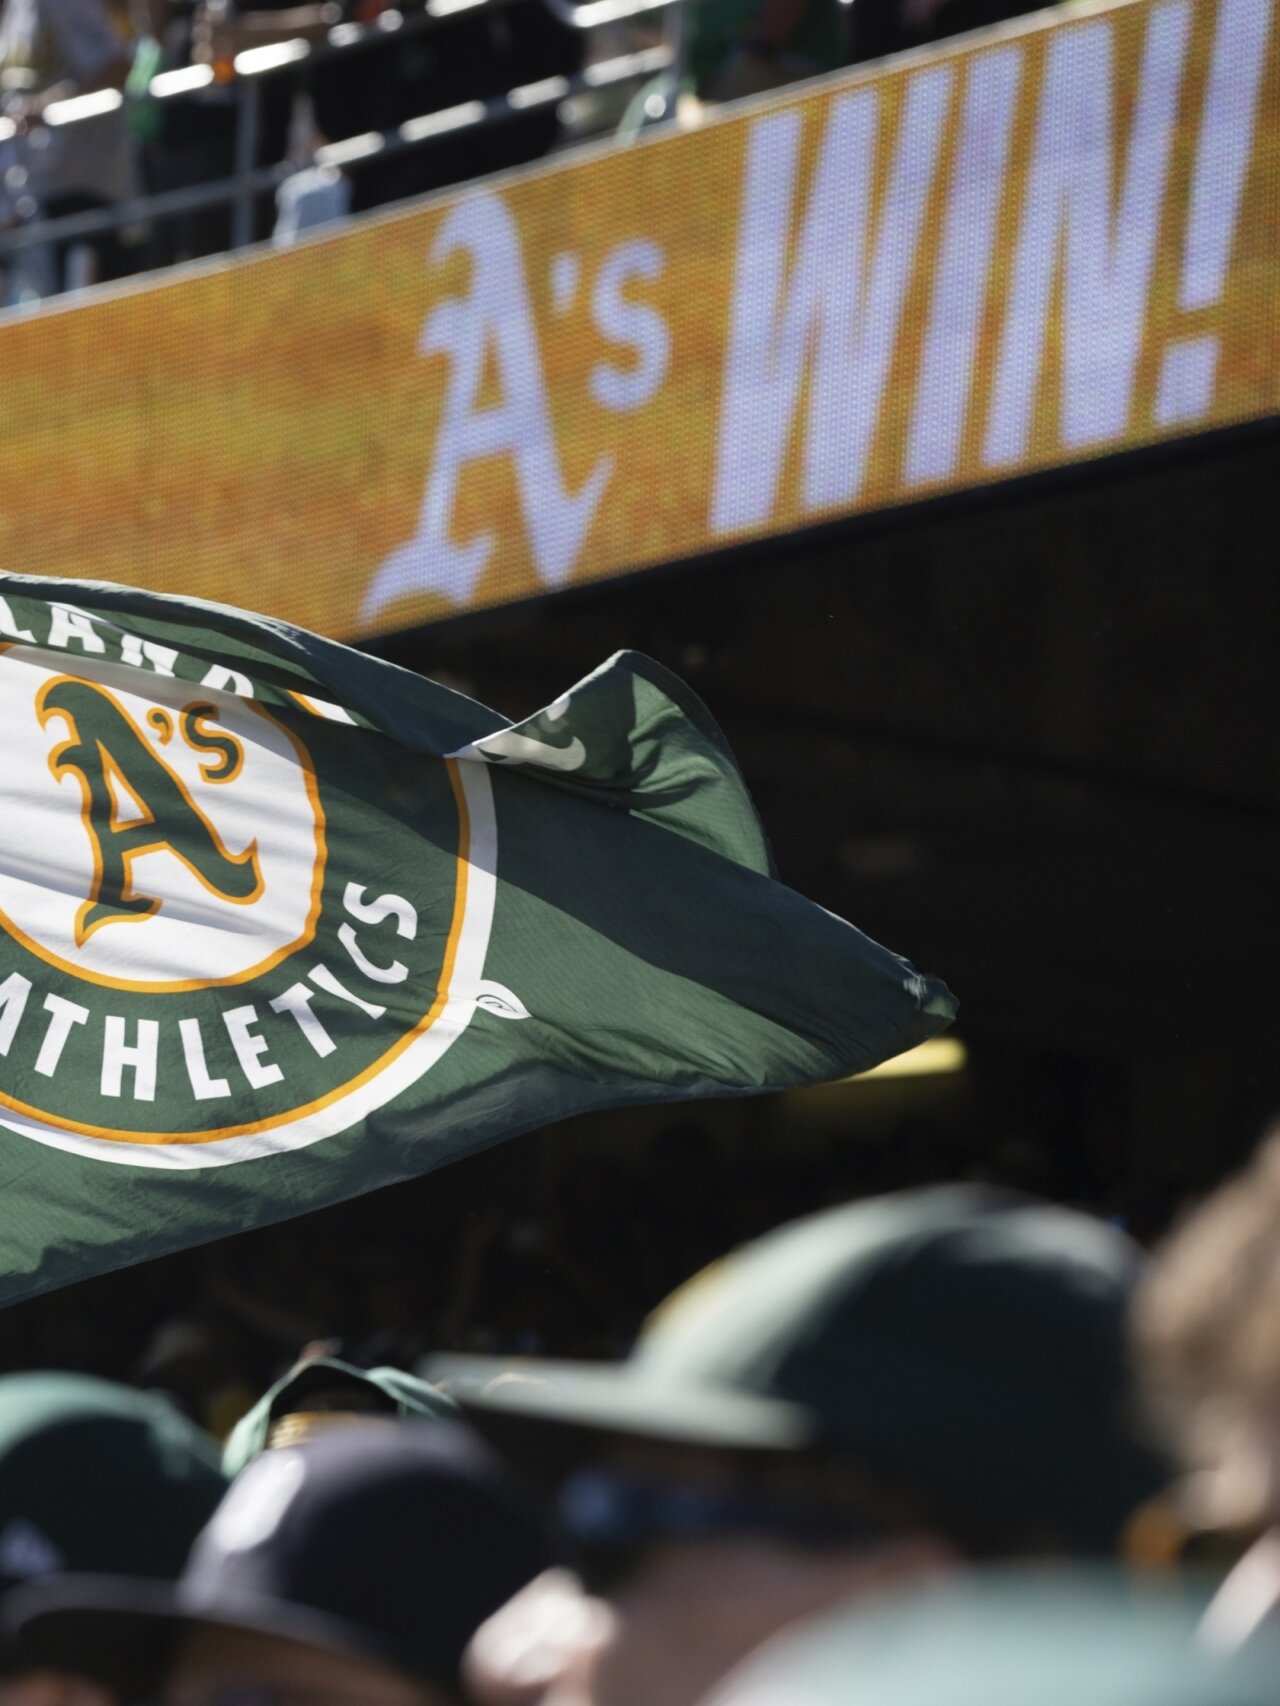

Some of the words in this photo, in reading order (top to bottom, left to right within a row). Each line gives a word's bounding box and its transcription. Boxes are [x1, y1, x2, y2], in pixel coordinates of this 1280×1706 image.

[360, 191, 670, 624] A's
[710, 0, 1274, 533] WIN!
[36, 676, 265, 948] A's
